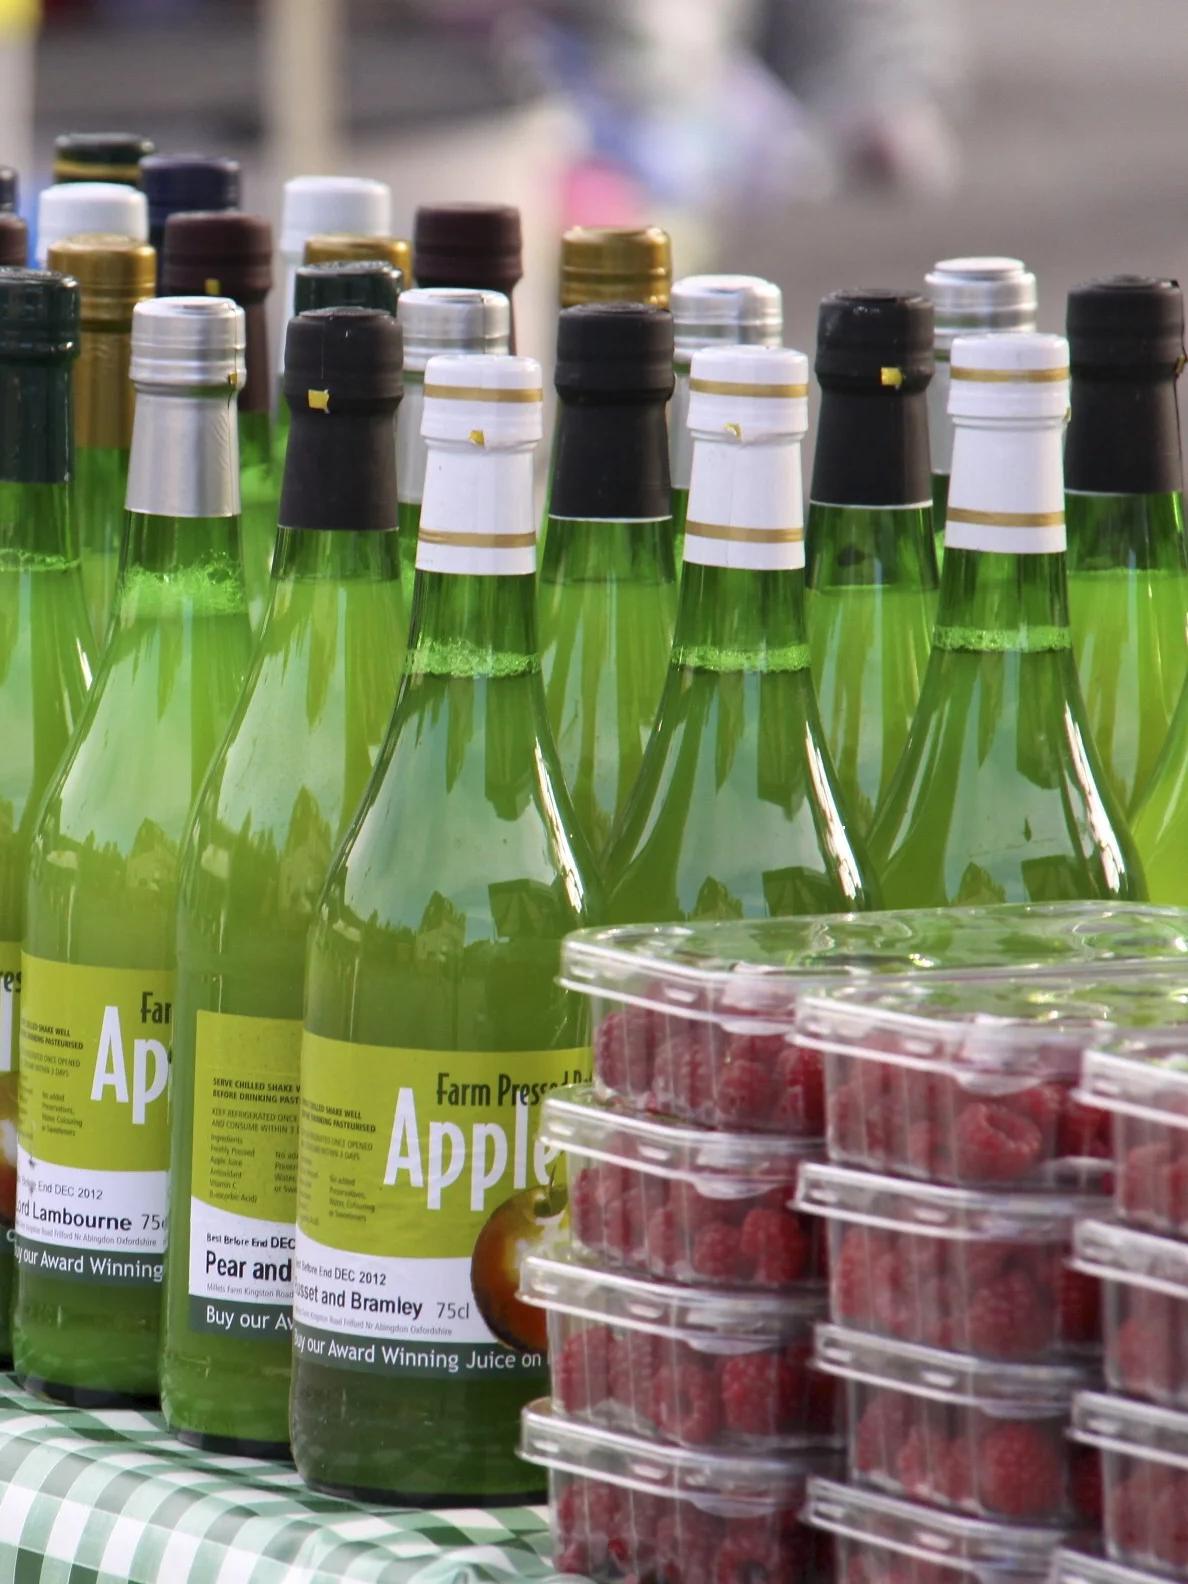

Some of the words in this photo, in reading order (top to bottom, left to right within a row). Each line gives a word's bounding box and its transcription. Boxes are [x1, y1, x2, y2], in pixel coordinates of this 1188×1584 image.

[213, 1077, 232, 1088] SERVE
[235, 1080, 265, 1090] CHILLED
[268, 1083, 292, 1092] SHAKE
[436, 1072, 492, 1107] Farm
[212, 1089, 237, 1099] BEFORE
[240, 1092, 278, 1103] DRINKING
[212, 1107, 226, 1116] KEEP
[227, 1109, 275, 1121] REFRIGERATED
[278, 1114, 297, 1123] ONCE
[344, 1109, 361, 1119] WELL
[226, 1121, 258, 1132] CONSUME
[261, 1124, 287, 1133] WITHIN
[333, 1120, 376, 1133] PASTEURISED
[275, 1151, 285, 1159] No
[383, 1086, 563, 1212] Apple
[38, 1180, 53, 1194] End
[54, 1183, 75, 1197] DEC
[77, 1187, 104, 1201] 2012
[16, 1199, 30, 1217] ord
[32, 1200, 133, 1231] Lambourne
[83, 1234, 115, 1246] Abingdon
[116, 1236, 157, 1247] Oxfordshire
[206, 1232, 222, 1243] Best
[223, 1234, 250, 1247] Before
[251, 1238, 268, 1248] End
[270, 1236, 296, 1250] DEC
[23, 1248, 39, 1265] our
[40, 1249, 84, 1273] Award
[90, 1256, 165, 1283] Winning
[205, 1250, 247, 1279] Pear
[252, 1258, 292, 1282] and
[319, 1265, 332, 1278] End
[334, 1266, 355, 1282] DEC
[359, 1271, 387, 1286] 2012
[206, 1283, 226, 1292] Millets
[227, 1285, 243, 1294] Farm
[244, 1287, 274, 1299] Kingston
[275, 1290, 294, 1299] Road
[321, 1289, 346, 1308] and
[351, 1291, 423, 1320] Bramley
[436, 1301, 470, 1319] 75cl
[206, 1305, 235, 1330] Buy
[240, 1312, 270, 1330] our
[365, 1320, 374, 1330] Nr
[374, 1323, 409, 1335] Abingdon
[410, 1325, 453, 1336] Oxfordshire
[307, 1336, 325, 1355] our
[327, 1339, 376, 1363] Award
[381, 1345, 459, 1373] Winning
[465, 1350, 516, 1369] Juice
[521, 1352, 541, 1368] on
